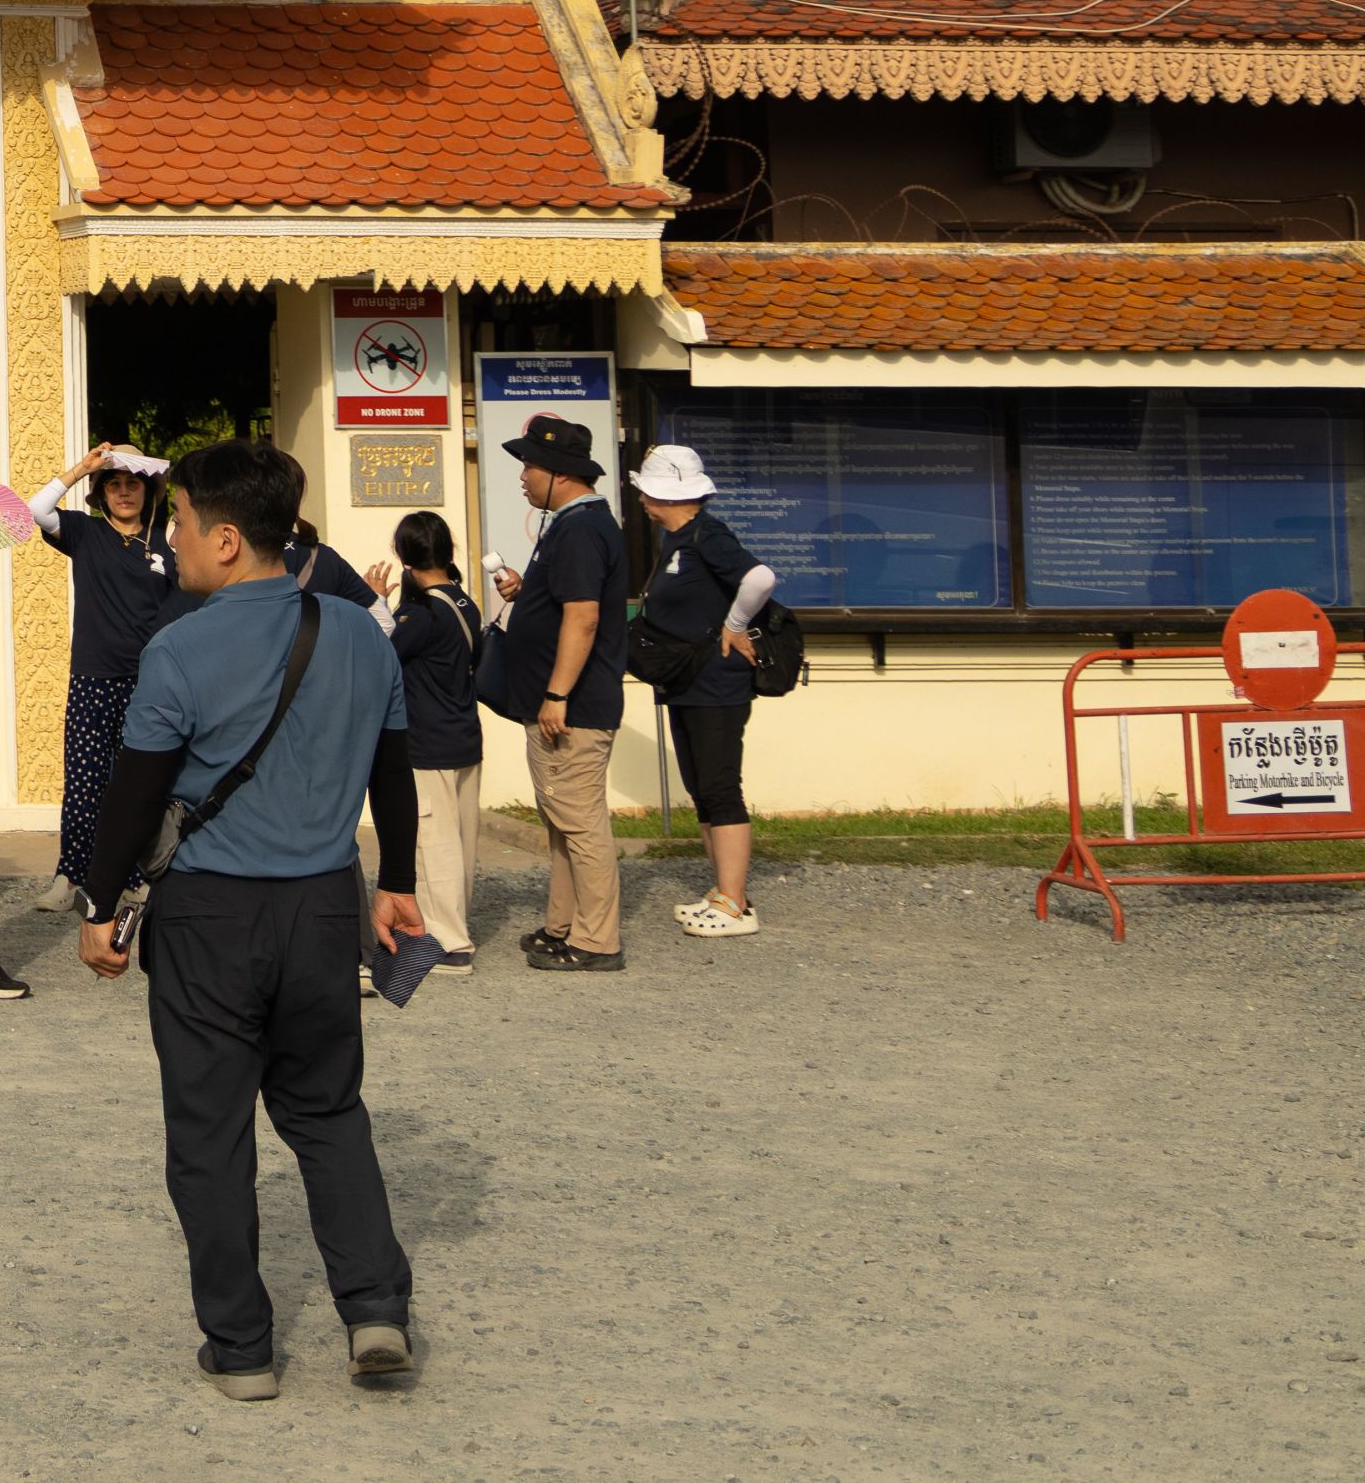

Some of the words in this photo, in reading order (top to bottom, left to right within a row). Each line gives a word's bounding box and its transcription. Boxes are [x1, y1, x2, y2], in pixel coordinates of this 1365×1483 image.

[504, 388, 529, 397] Please
[530, 388, 552, 396] Dress
[553, 388, 587, 398] Modestly
[361, 408, 374, 417] NO
[375, 408, 402, 417] DRONE
[403, 408, 425, 417] ZONE
[365, 481, 431, 496] ENTRY
[1229, 774, 1259, 793] Parking
[1259, 772, 1299, 790] Motorbike
[1300, 773, 1314, 787] and
[1315, 771, 1344, 790] Bicycle
